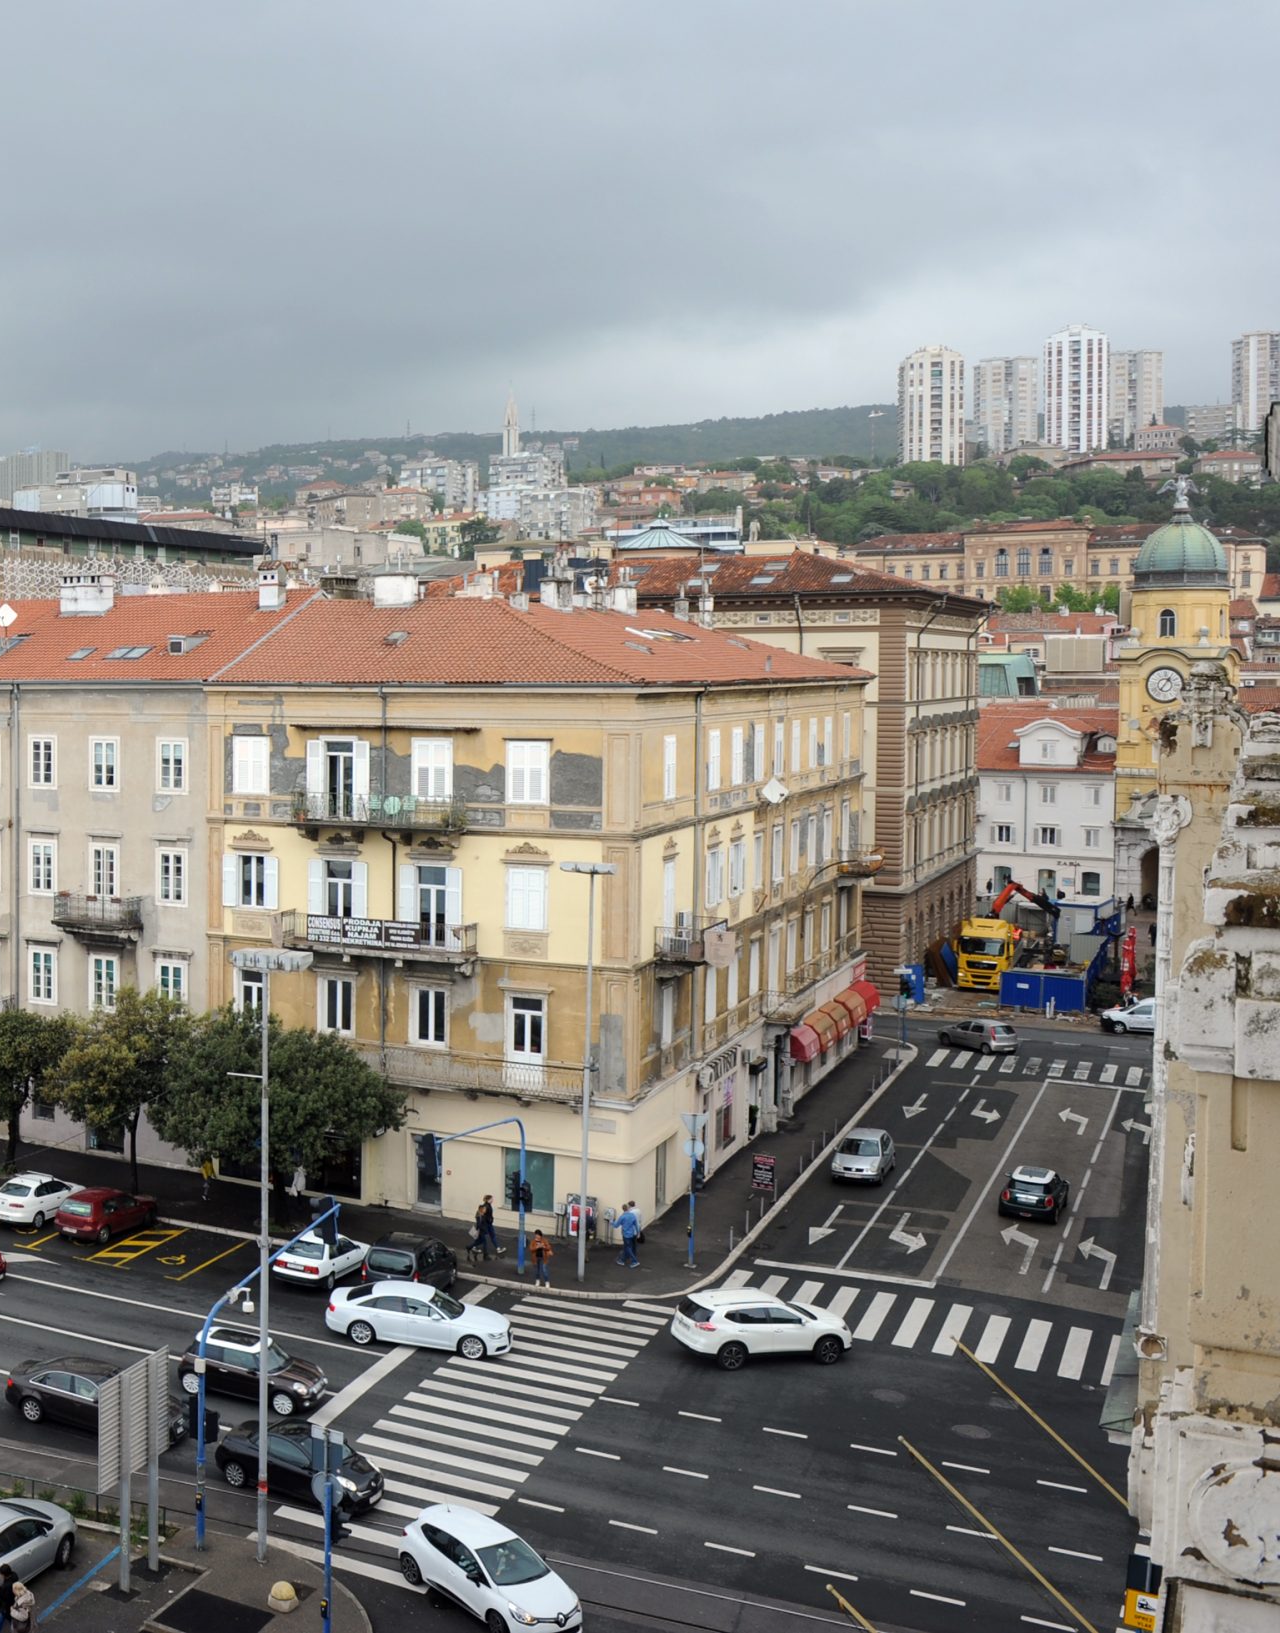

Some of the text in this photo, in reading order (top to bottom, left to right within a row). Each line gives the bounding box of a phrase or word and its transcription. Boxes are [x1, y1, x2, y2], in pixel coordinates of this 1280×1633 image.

[308, 916, 341, 930] CONSENSUS
[342, 918, 381, 927] PRODAJA
[345, 925, 379, 934] KUPNJA
[347, 931, 377, 940] NAJAM
